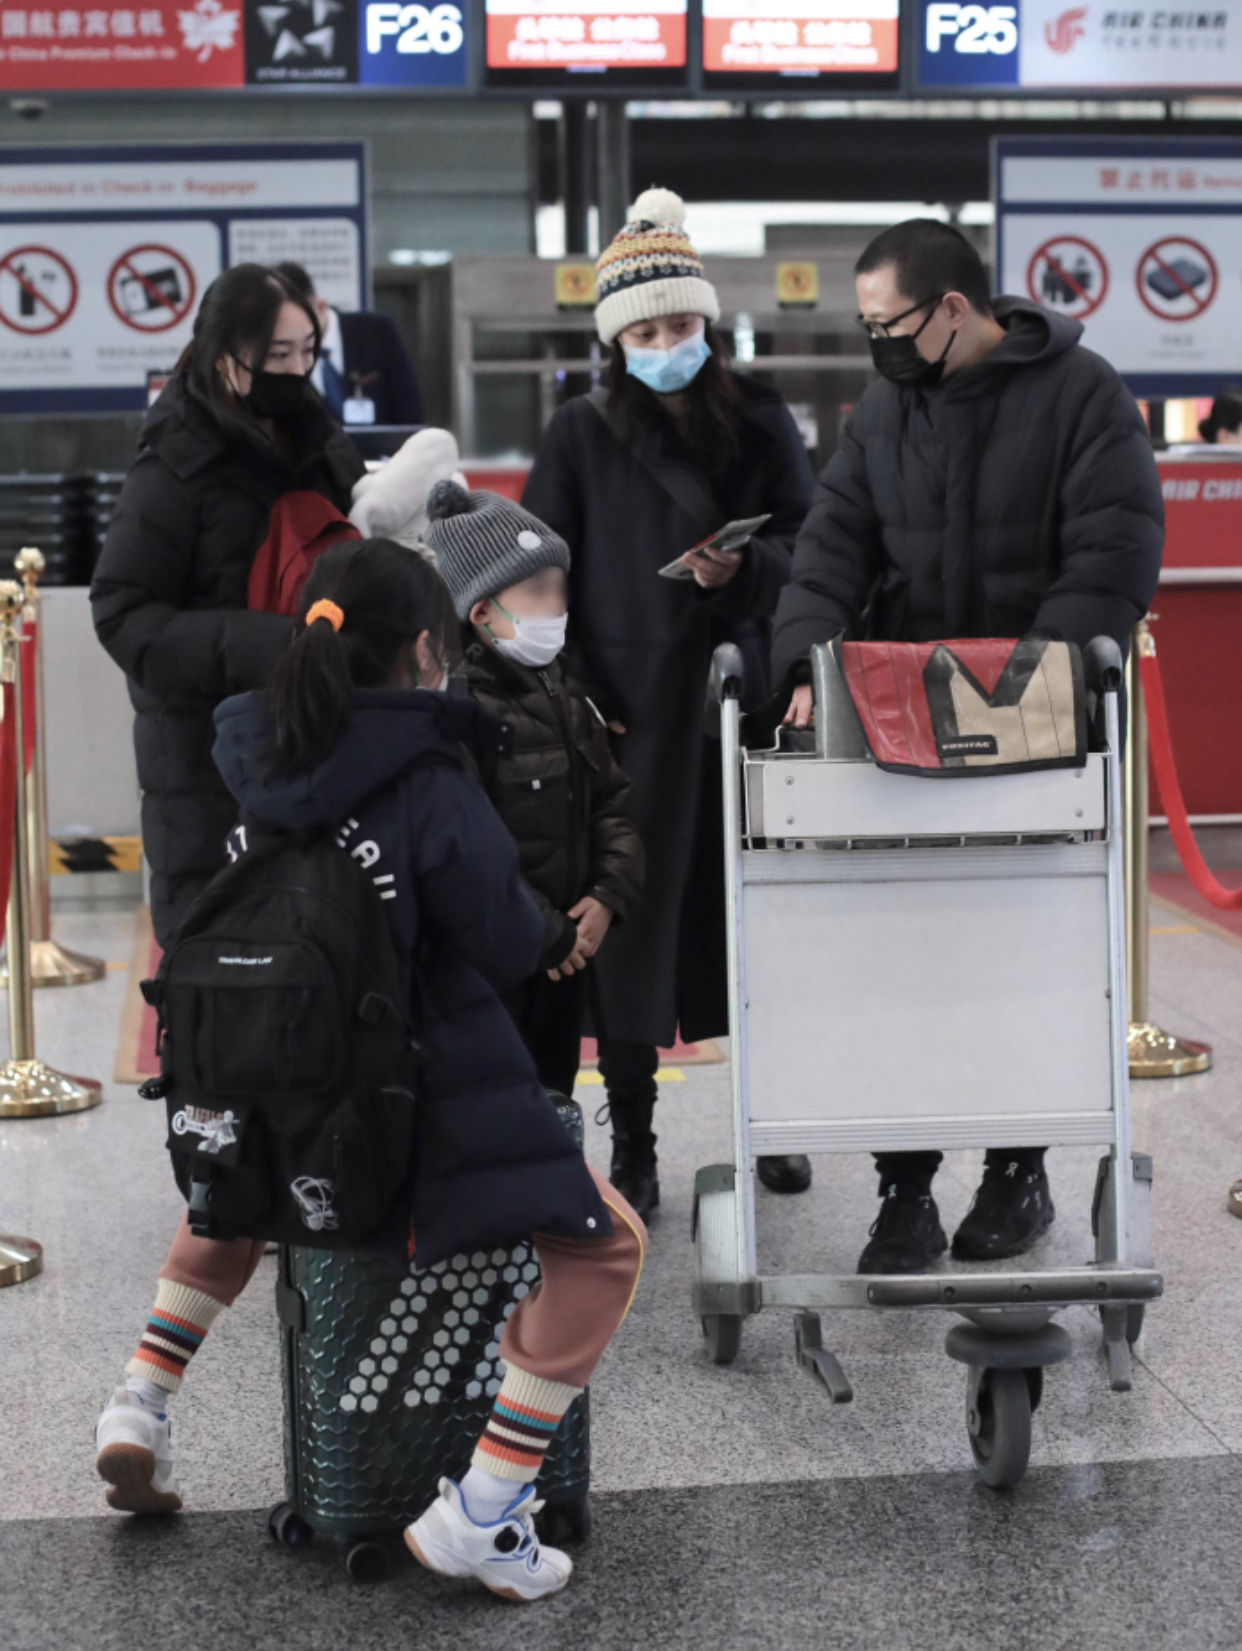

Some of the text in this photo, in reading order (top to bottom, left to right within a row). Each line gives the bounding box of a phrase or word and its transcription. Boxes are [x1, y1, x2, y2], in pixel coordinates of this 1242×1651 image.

[365, 3, 464, 54] F26
[926, 3, 1018, 54] F25
[1101, 10, 1228, 29] AIR CHINA
[1162, 479, 1200, 501] AIR
